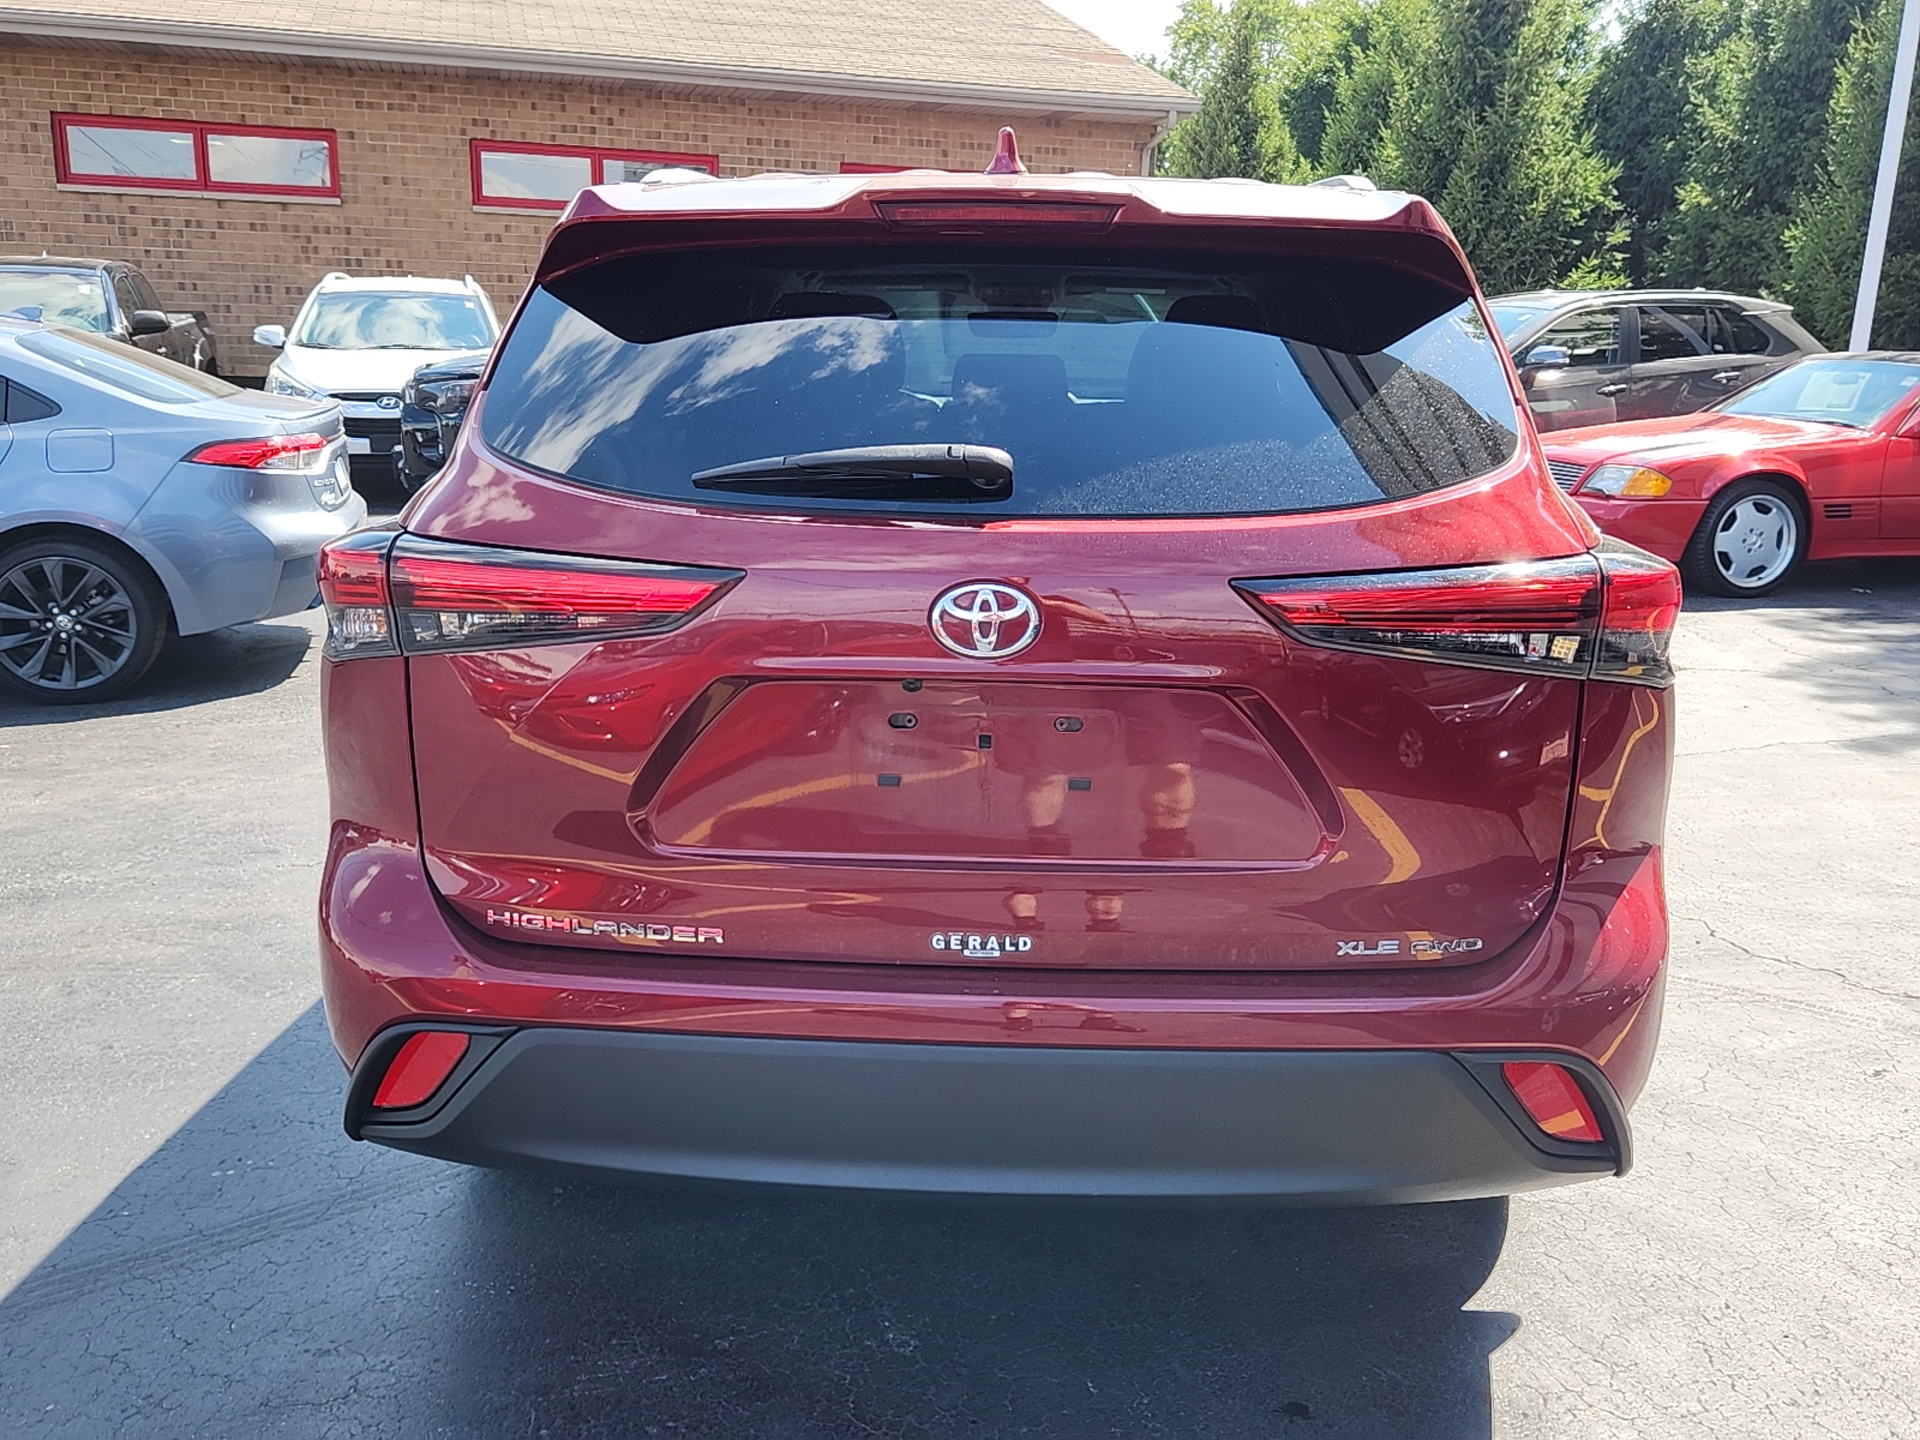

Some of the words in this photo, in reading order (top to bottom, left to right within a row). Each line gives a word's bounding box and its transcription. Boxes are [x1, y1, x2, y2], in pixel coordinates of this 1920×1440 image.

[486, 909, 725, 944] HIGHLANDER
[931, 934, 1033, 952] GERALD
[1336, 940, 1400, 956] XLE
[1410, 937, 1483, 955] AWD
